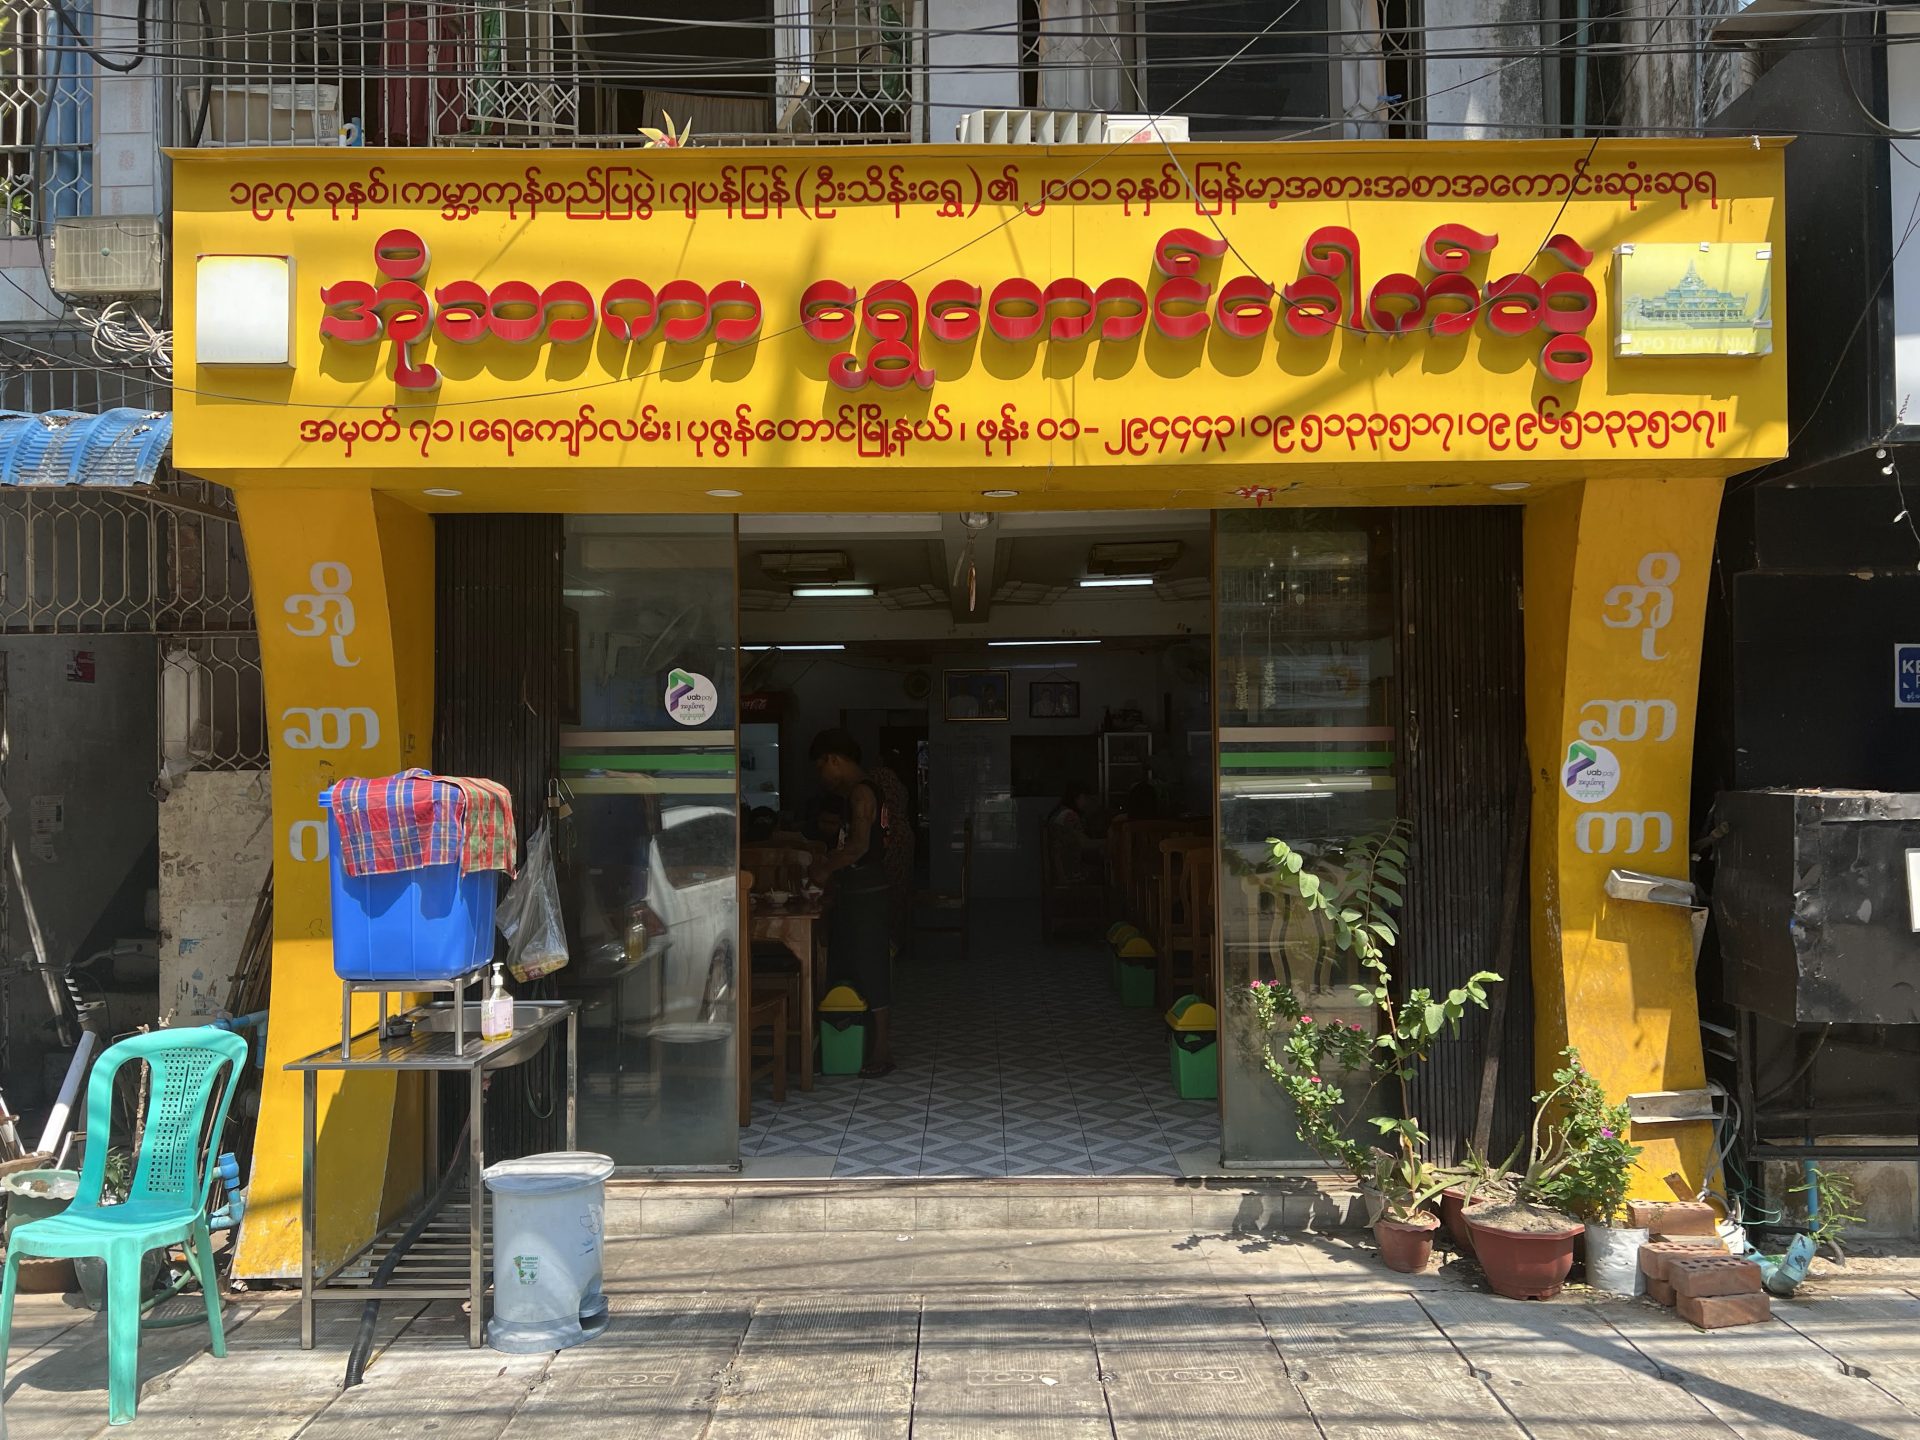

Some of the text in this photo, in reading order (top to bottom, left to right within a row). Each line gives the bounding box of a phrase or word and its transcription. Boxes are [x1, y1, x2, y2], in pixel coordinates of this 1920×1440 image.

[320, 228, 765, 390] အိုဆာကာ
[300, 404, 401, 457] အမှတ်
[686, 693, 701, 701] uab
[1586, 768, 1602, 776] uab
